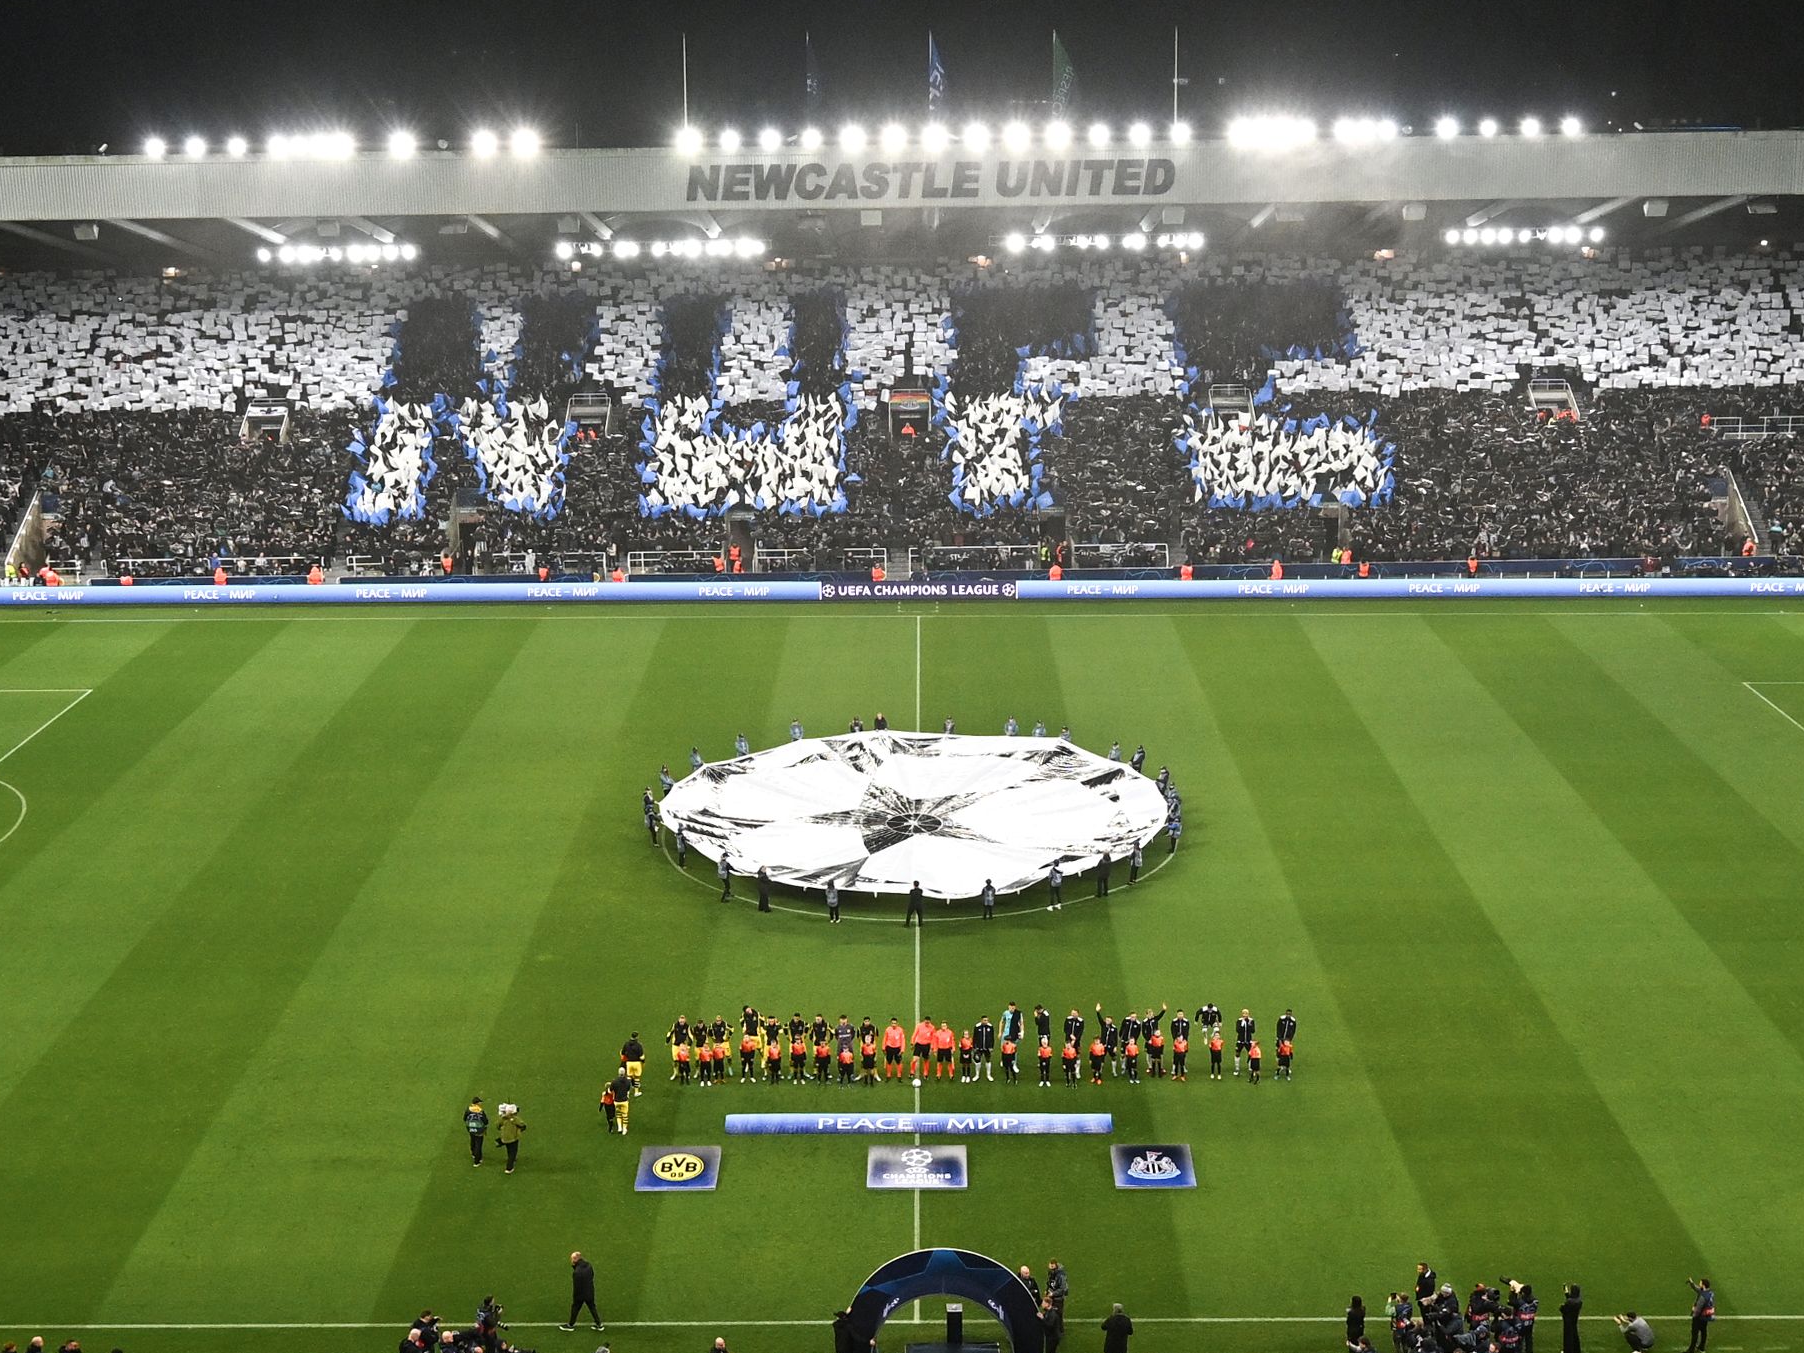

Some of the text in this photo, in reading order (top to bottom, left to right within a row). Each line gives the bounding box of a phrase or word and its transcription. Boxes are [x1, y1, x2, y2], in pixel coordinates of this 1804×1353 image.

[686, 158, 1176, 202] NEWCASTLE UNITED
[527, 586, 598, 597] PEACE МИР
[698, 585, 770, 596] PEACE МИР
[837, 584, 1000, 596] UEFA CHAMPIONS LEAGUE
[1067, 584, 1138, 595] PEACE МИР
[1237, 583, 1309, 594] PEACE МИР
[1408, 582, 1480, 593] PEACE МИР
[1579, 582, 1651, 593] PEACE МИР
[1750, 582, 1785, 593] PEACE
[12, 590, 84, 601] PEACE МИР
[184, 589, 255, 600] PEACE МИР
[356, 588, 427, 599] PEACE МИР
[817, 1117, 1019, 1131] PEACE МИР
[660, 1157, 698, 1173] BVB
